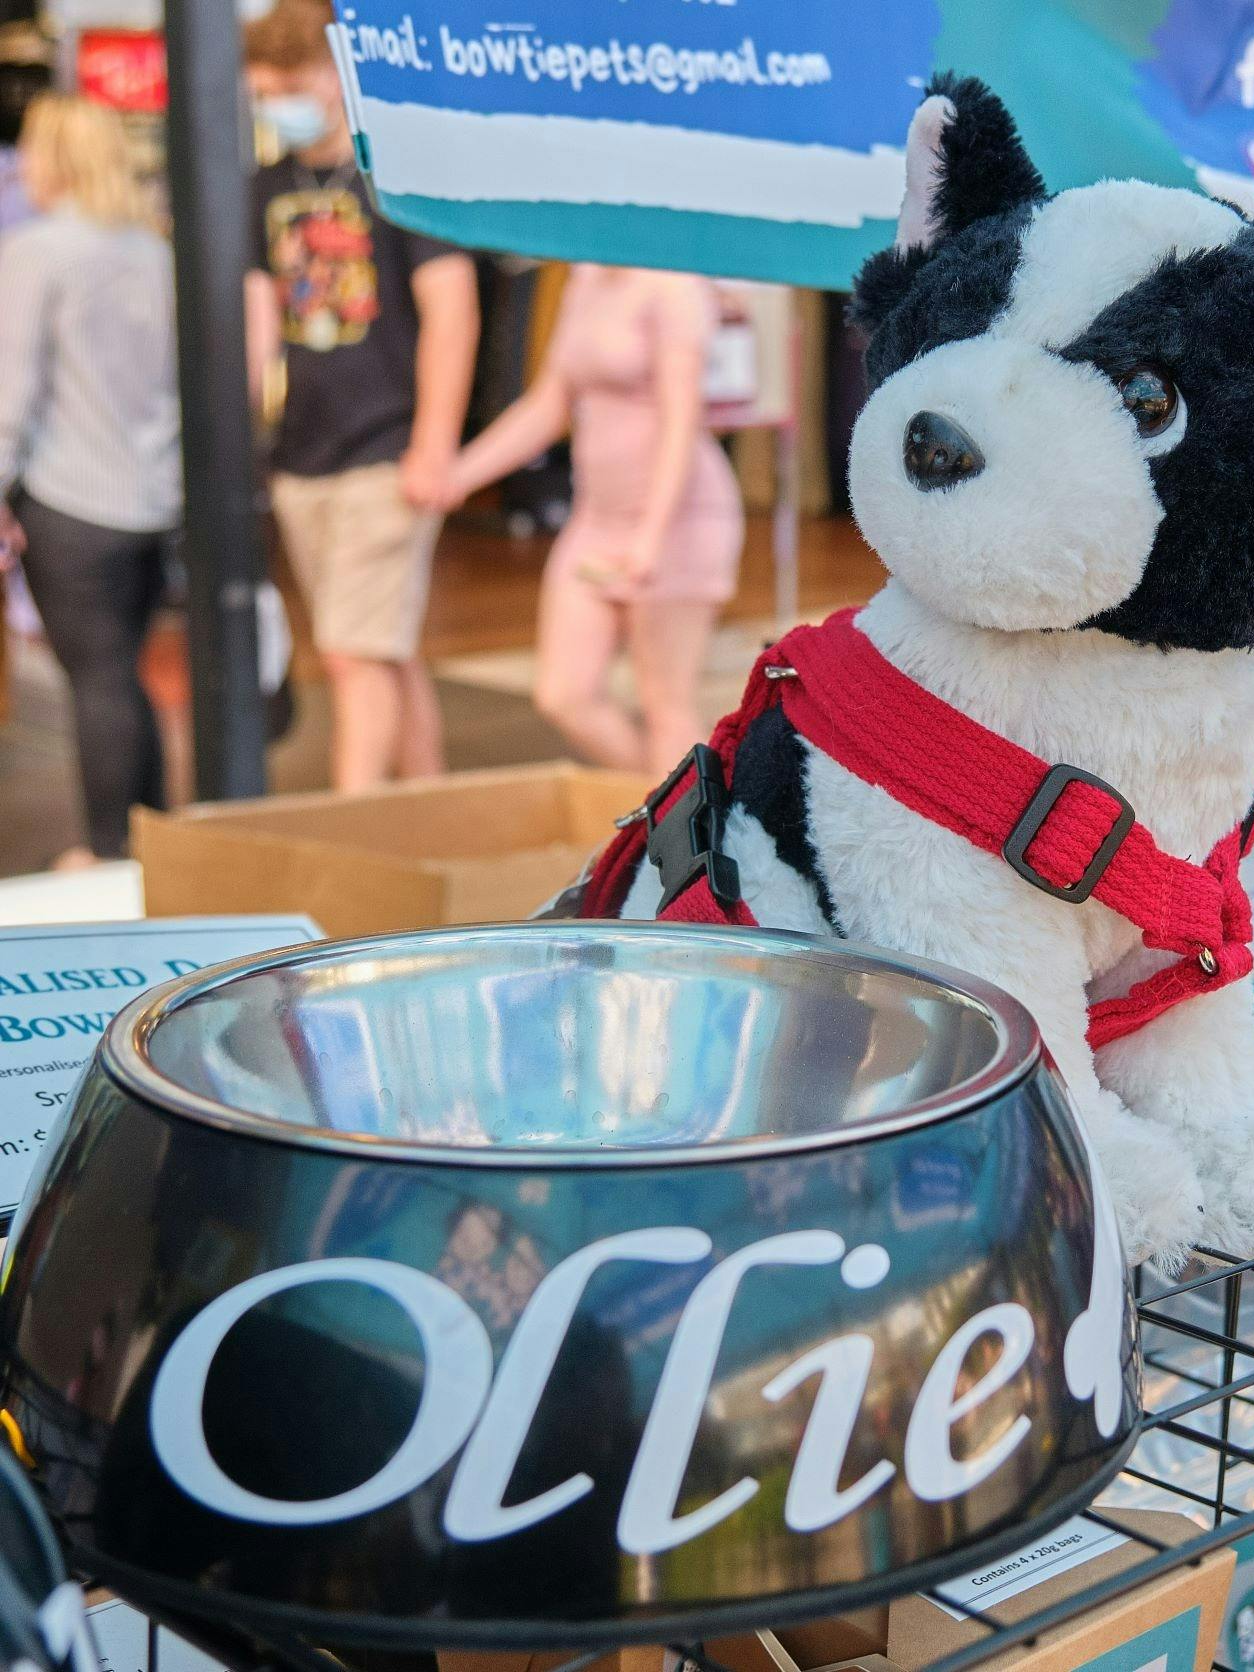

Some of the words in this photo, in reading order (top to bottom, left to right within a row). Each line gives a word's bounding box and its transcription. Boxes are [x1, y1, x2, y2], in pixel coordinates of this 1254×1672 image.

[439, 23, 832, 94] bowtiepets@gmail.com
[0, 1011, 117, 1042] BOW
[0, 1057, 90, 1078] ersonalise
[149, 1226, 1035, 1554] Ollie
[971, 1562, 1021, 1586] Contains
[1019, 1556, 1029, 1565] 4
[1034, 1545, 1060, 1557] 20g
[1055, 1534, 1083, 1549] bags
